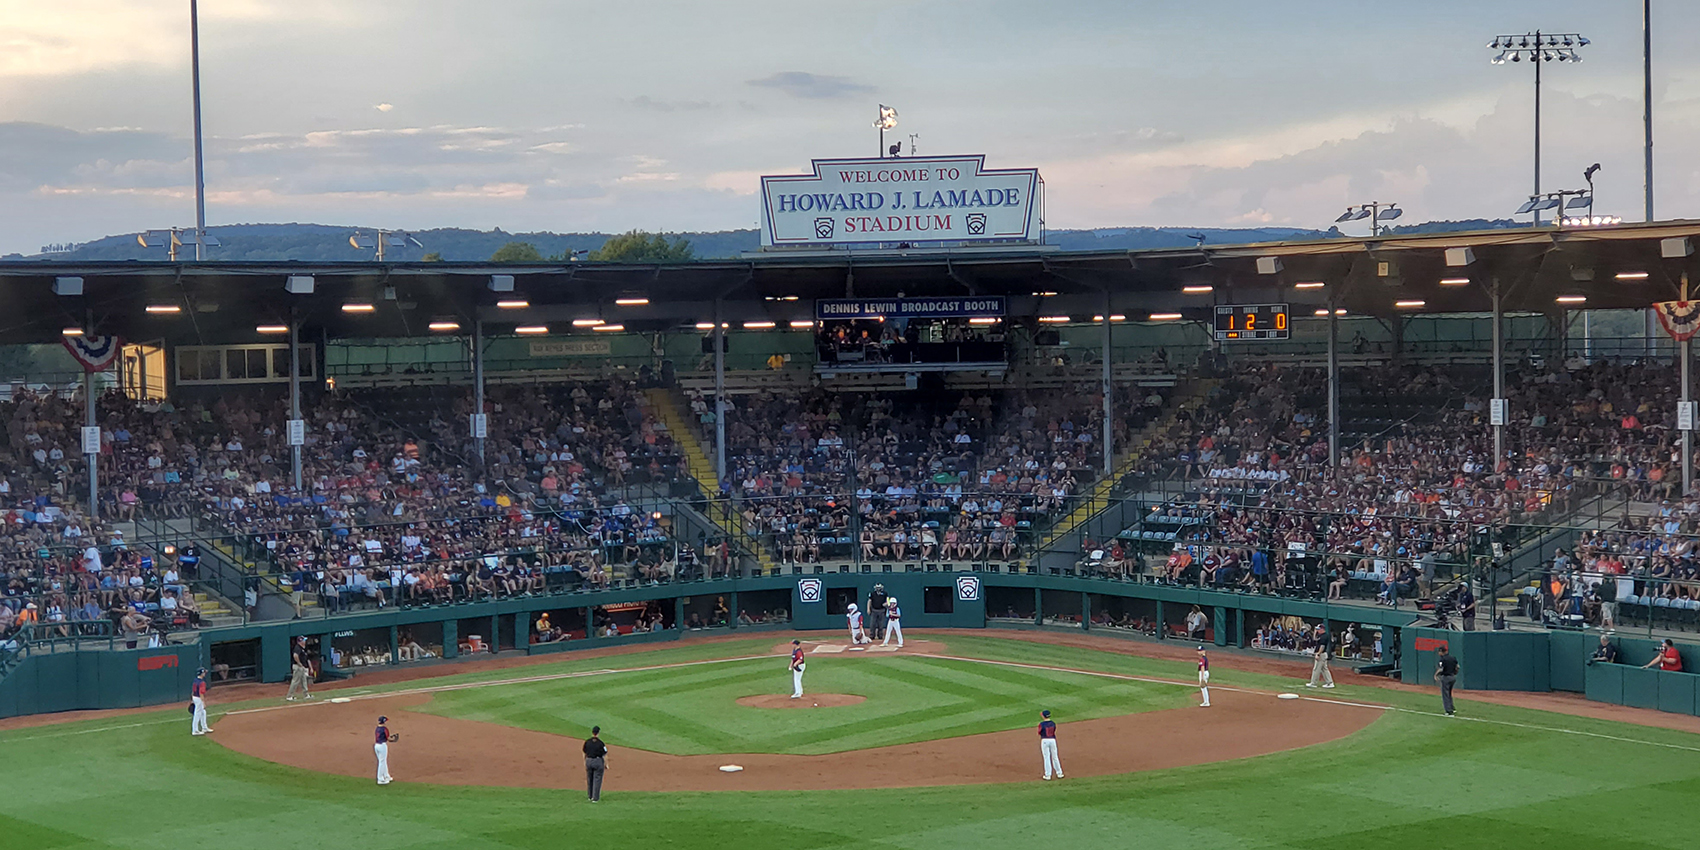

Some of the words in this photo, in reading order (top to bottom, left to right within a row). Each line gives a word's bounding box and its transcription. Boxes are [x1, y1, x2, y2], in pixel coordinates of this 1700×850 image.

[839, 169, 929, 183] WELCOME
[936, 168, 960, 181] TO
[778, 192, 884, 213] HOWARD
[892, 191, 906, 210] J.
[913, 188, 1020, 209] LAMADE
[844, 215, 952, 233] STADIUM
[823, 303, 860, 314] DENNIS
[864, 303, 897, 313] LEWIN
[901, 301, 959, 312] BROADCAST
[964, 301, 999, 311] BOOTH
[1229, 315, 1234, 330] 1
[1246, 314, 1255, 330] 2
[1277, 314, 1286, 329] 0
[138, 654, 179, 671] ESPN
